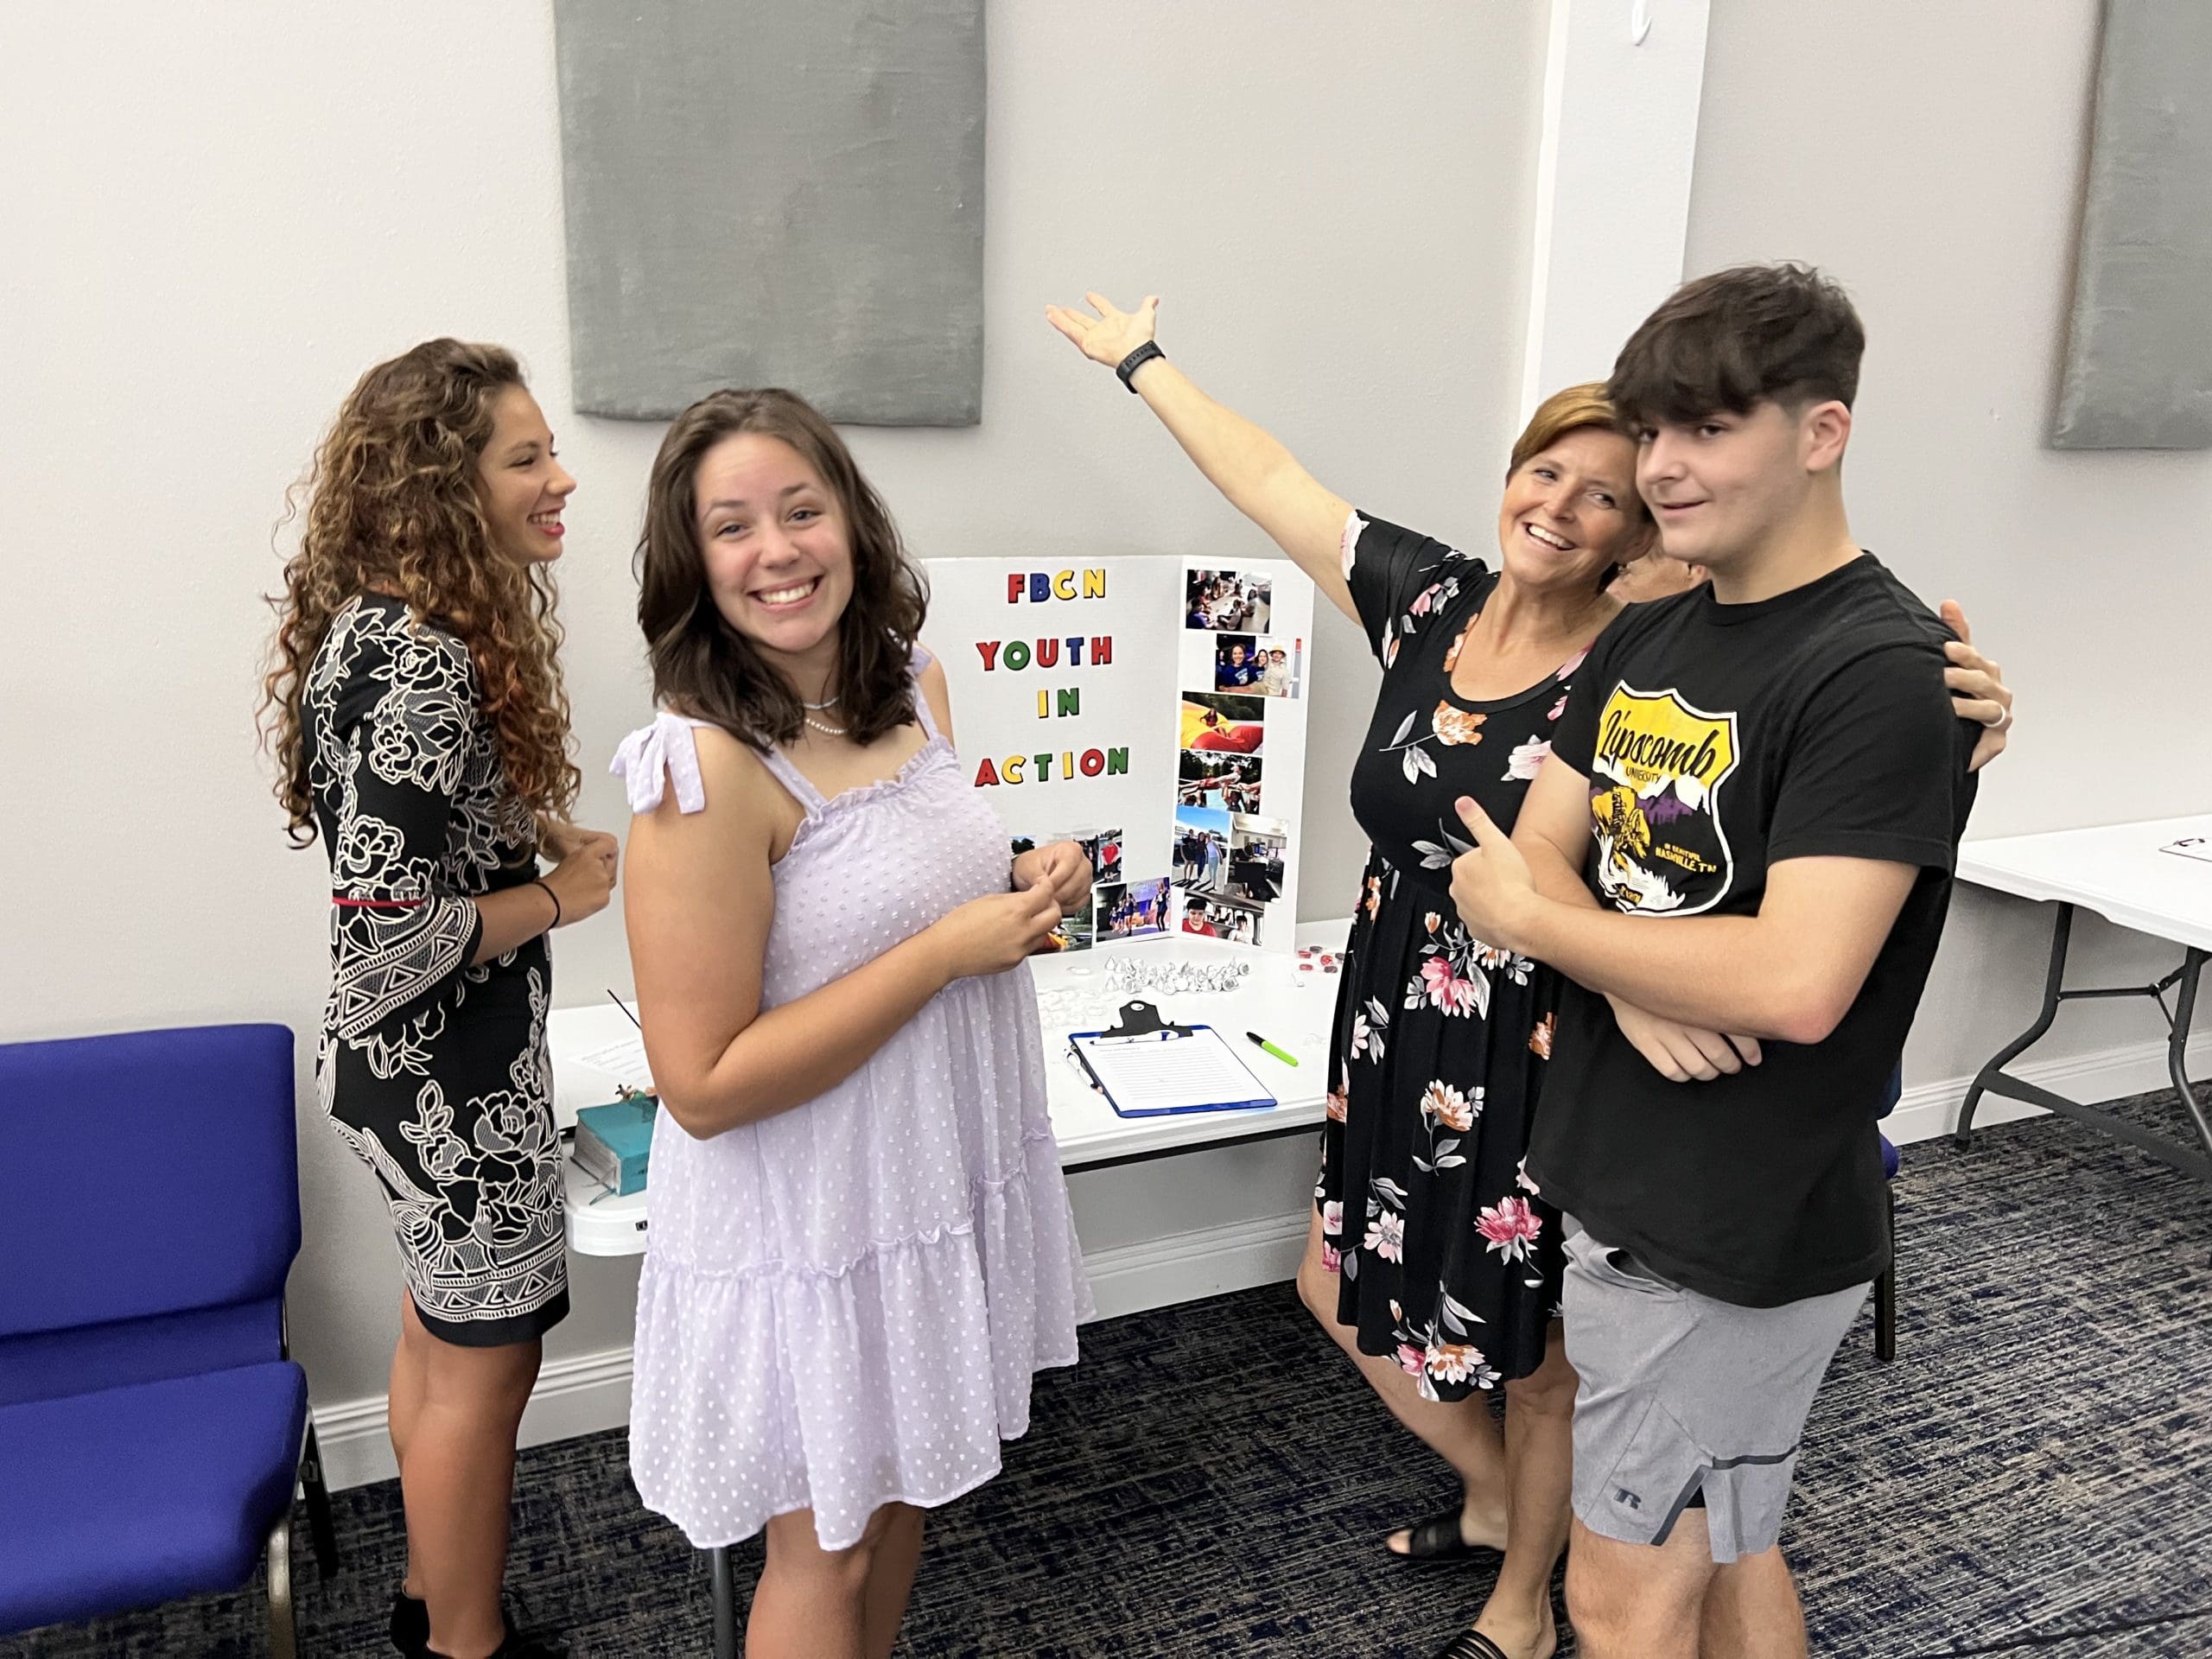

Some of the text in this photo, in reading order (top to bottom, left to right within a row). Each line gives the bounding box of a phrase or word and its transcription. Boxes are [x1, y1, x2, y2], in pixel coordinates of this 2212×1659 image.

[1007, 569, 1105, 603] FBCN
[976, 636, 1112, 671] YOUTH
[1038, 687, 1079, 719] IN
[1599, 709, 1719, 778] Lipscomb
[974, 747, 1129, 787] ACTION
